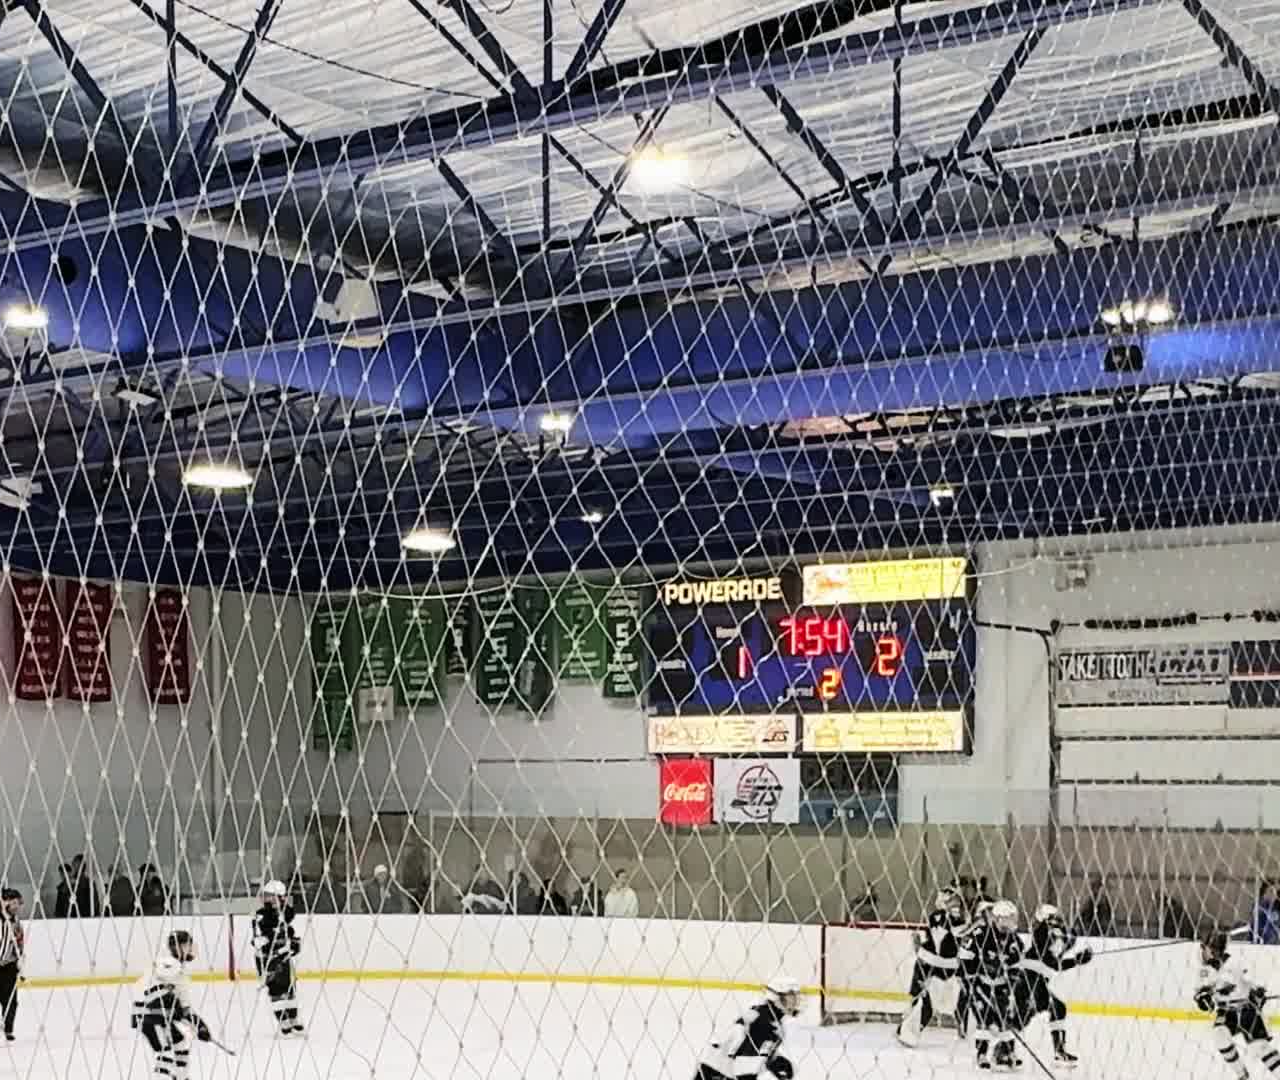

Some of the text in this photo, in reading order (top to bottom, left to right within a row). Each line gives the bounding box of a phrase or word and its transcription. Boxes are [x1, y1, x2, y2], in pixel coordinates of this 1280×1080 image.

[664, 578, 782, 605] POWERADE
[878, 638, 898, 675] 2
[822, 669, 840, 699] 2
